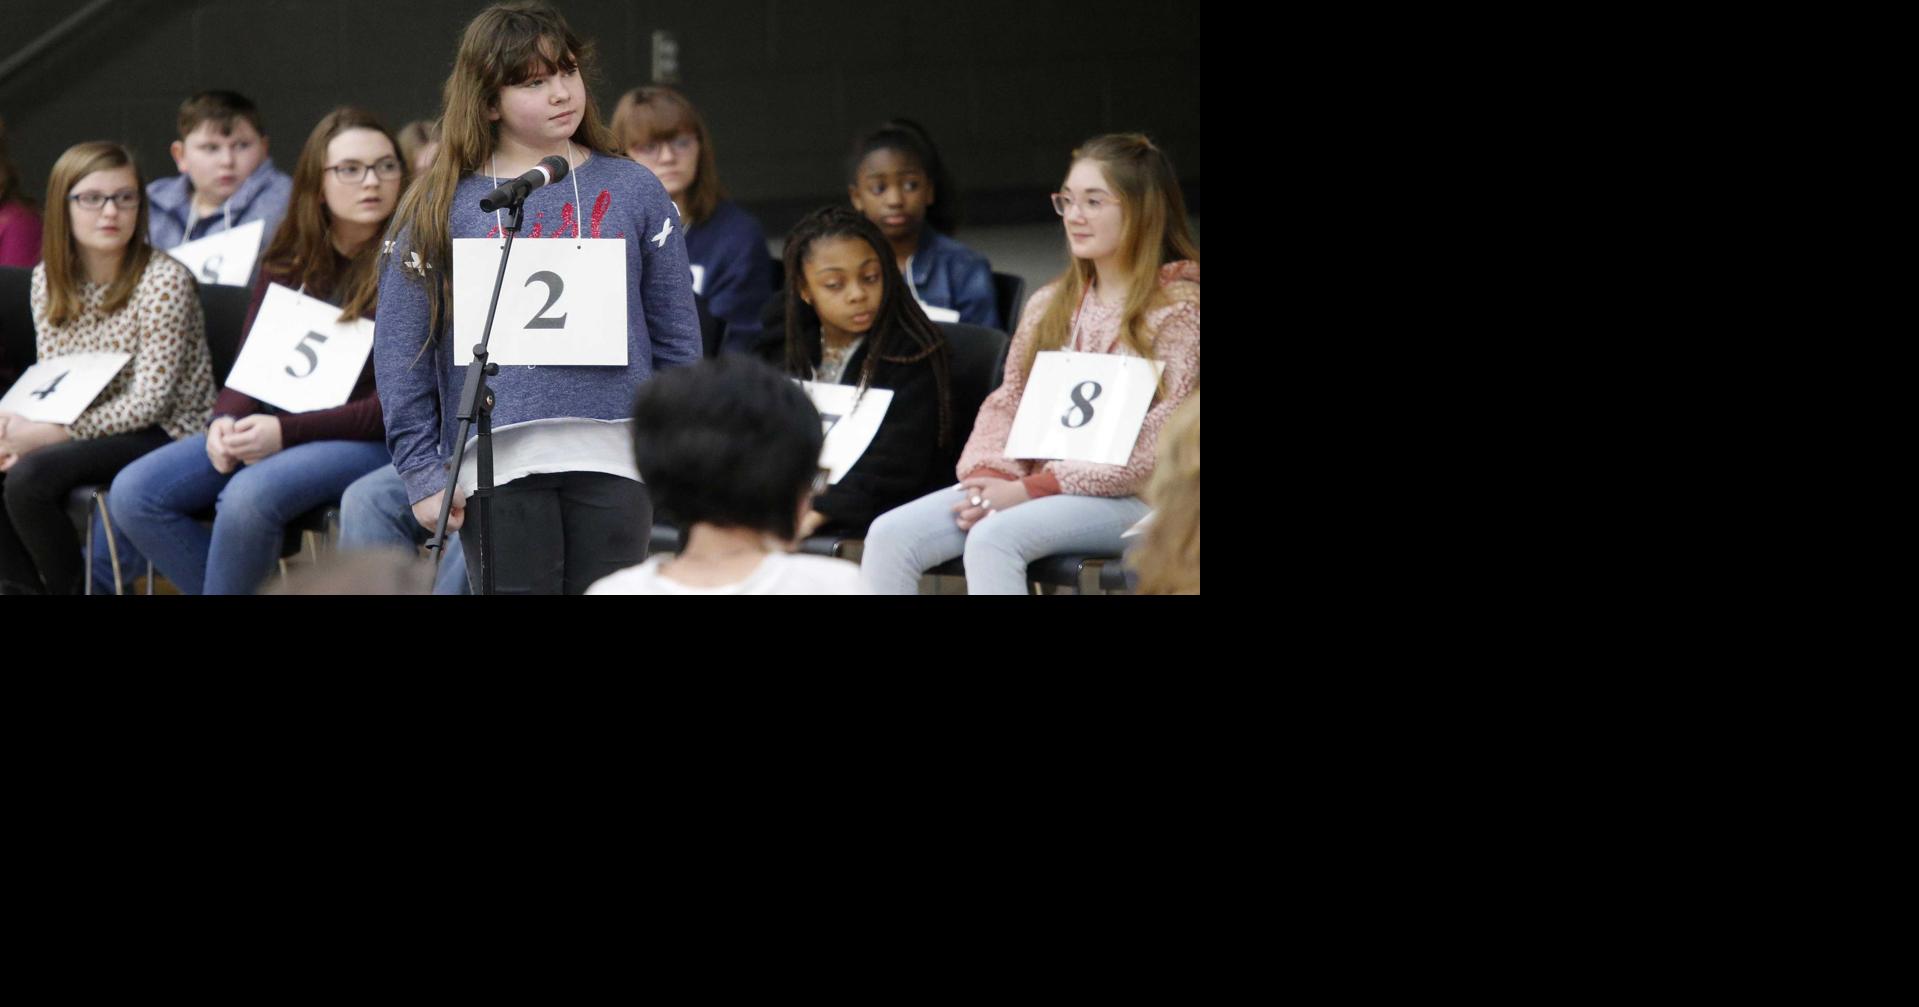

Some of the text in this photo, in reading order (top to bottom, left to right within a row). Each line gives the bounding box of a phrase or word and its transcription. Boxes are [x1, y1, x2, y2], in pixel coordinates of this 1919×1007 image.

[523, 270, 568, 330] 2
[285, 330, 328, 378] 5
[30, 369, 71, 400] 4
[1060, 380, 1103, 429] 8
